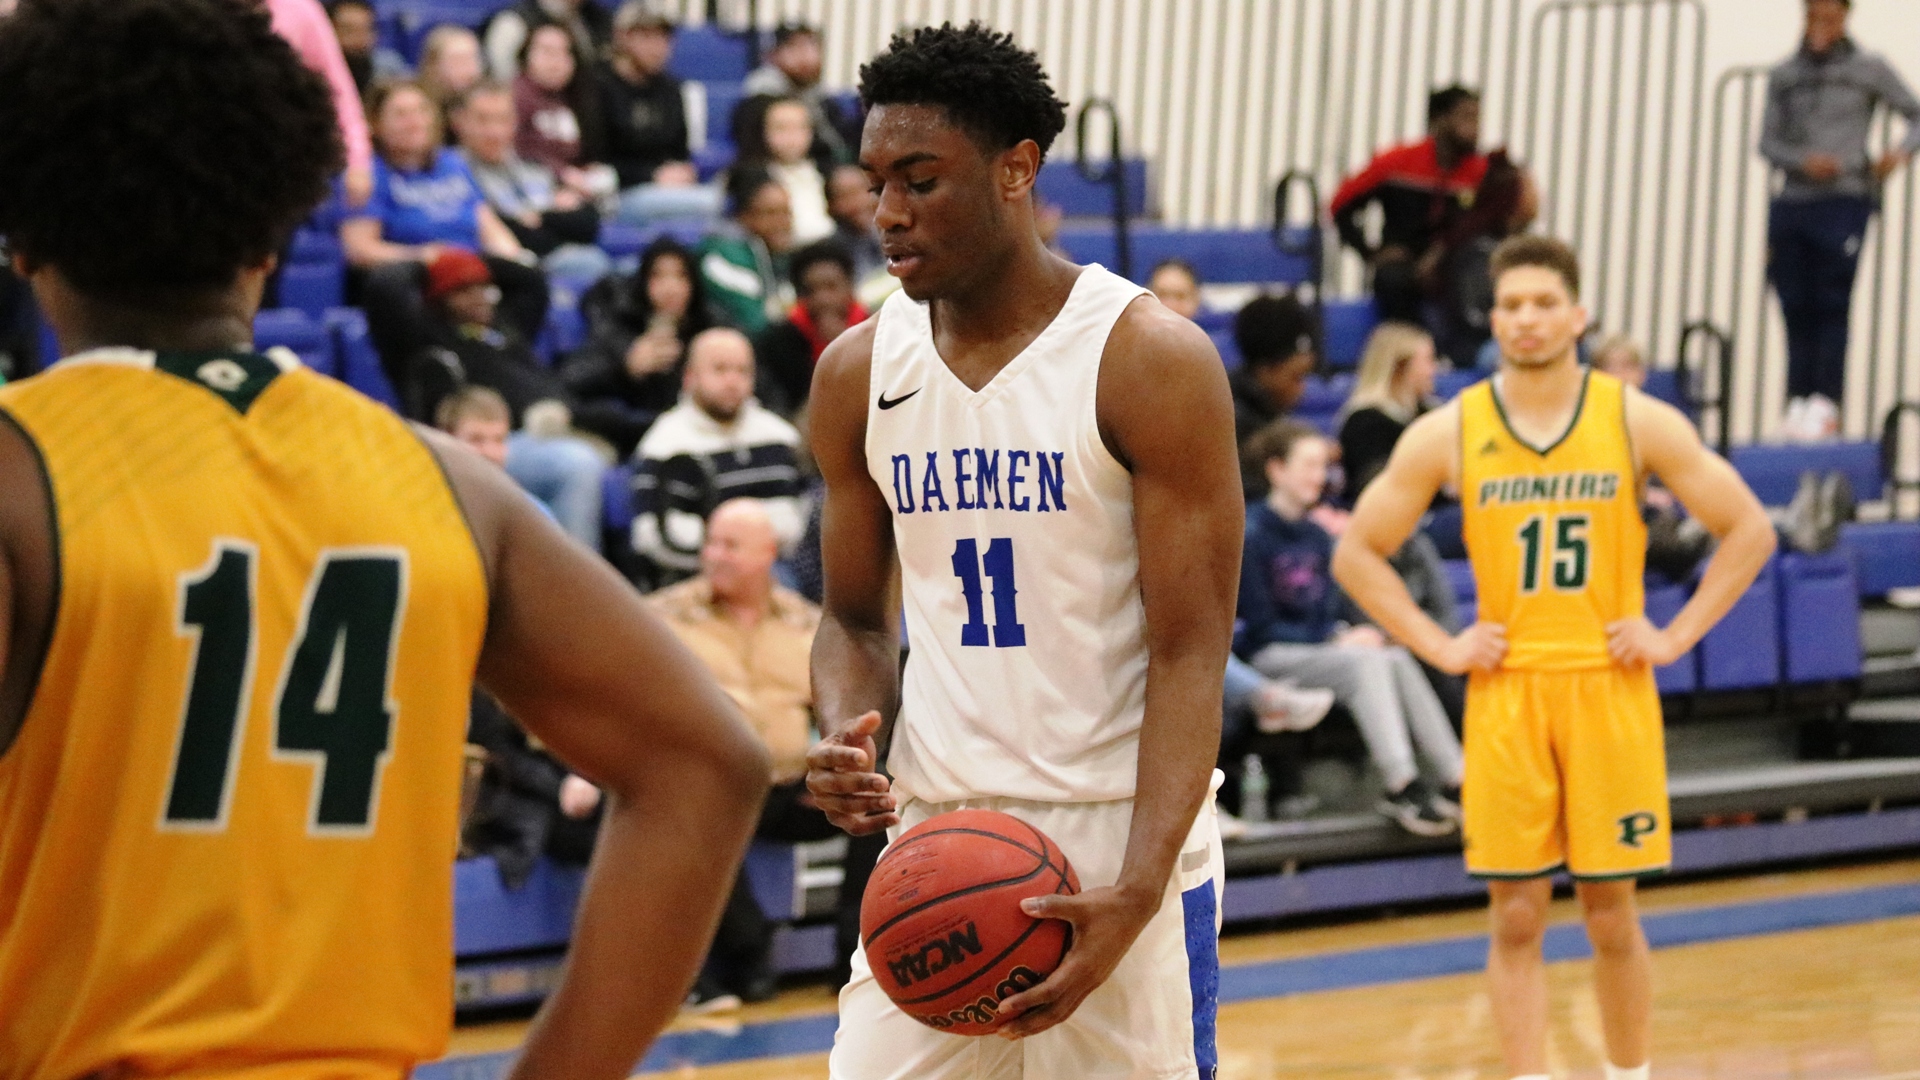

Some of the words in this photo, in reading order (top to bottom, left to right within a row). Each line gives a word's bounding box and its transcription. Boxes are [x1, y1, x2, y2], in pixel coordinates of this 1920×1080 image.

[891, 447, 1068, 514] DAEMEN
[1478, 472, 1620, 508] PIONEERS
[1517, 514, 1590, 593] 15
[950, 537, 1027, 648] 11
[157, 536, 410, 837] 14
[1616, 810, 1658, 849] P
[887, 920, 983, 989] NCAA
